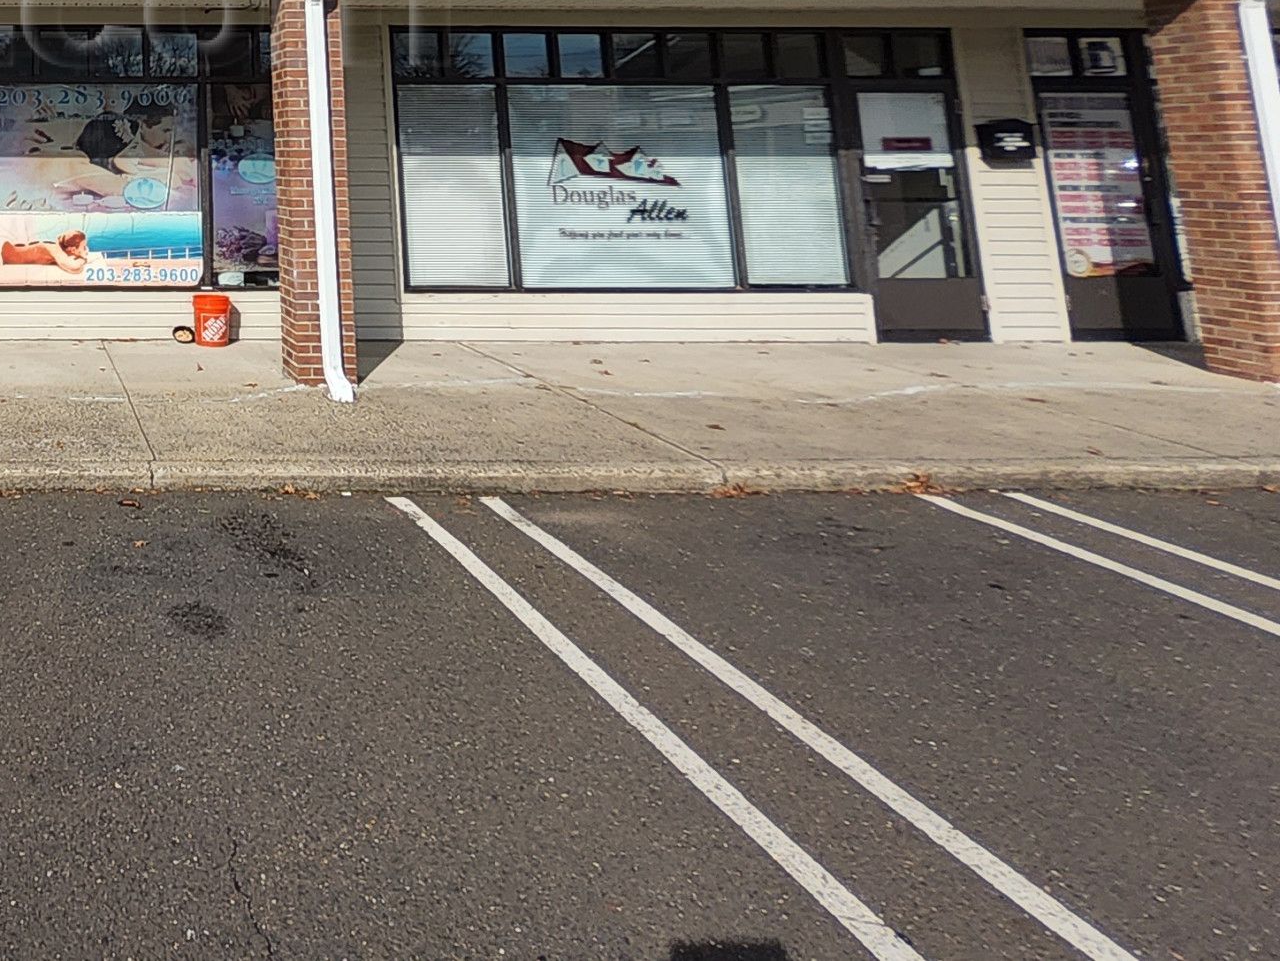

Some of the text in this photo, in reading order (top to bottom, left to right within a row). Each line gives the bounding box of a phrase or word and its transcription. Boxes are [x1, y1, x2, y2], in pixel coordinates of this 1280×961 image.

[551, 184, 637, 209] Douglas
[626, 198, 689, 224] Allen
[85, 267, 199, 282] 203-283-9600
